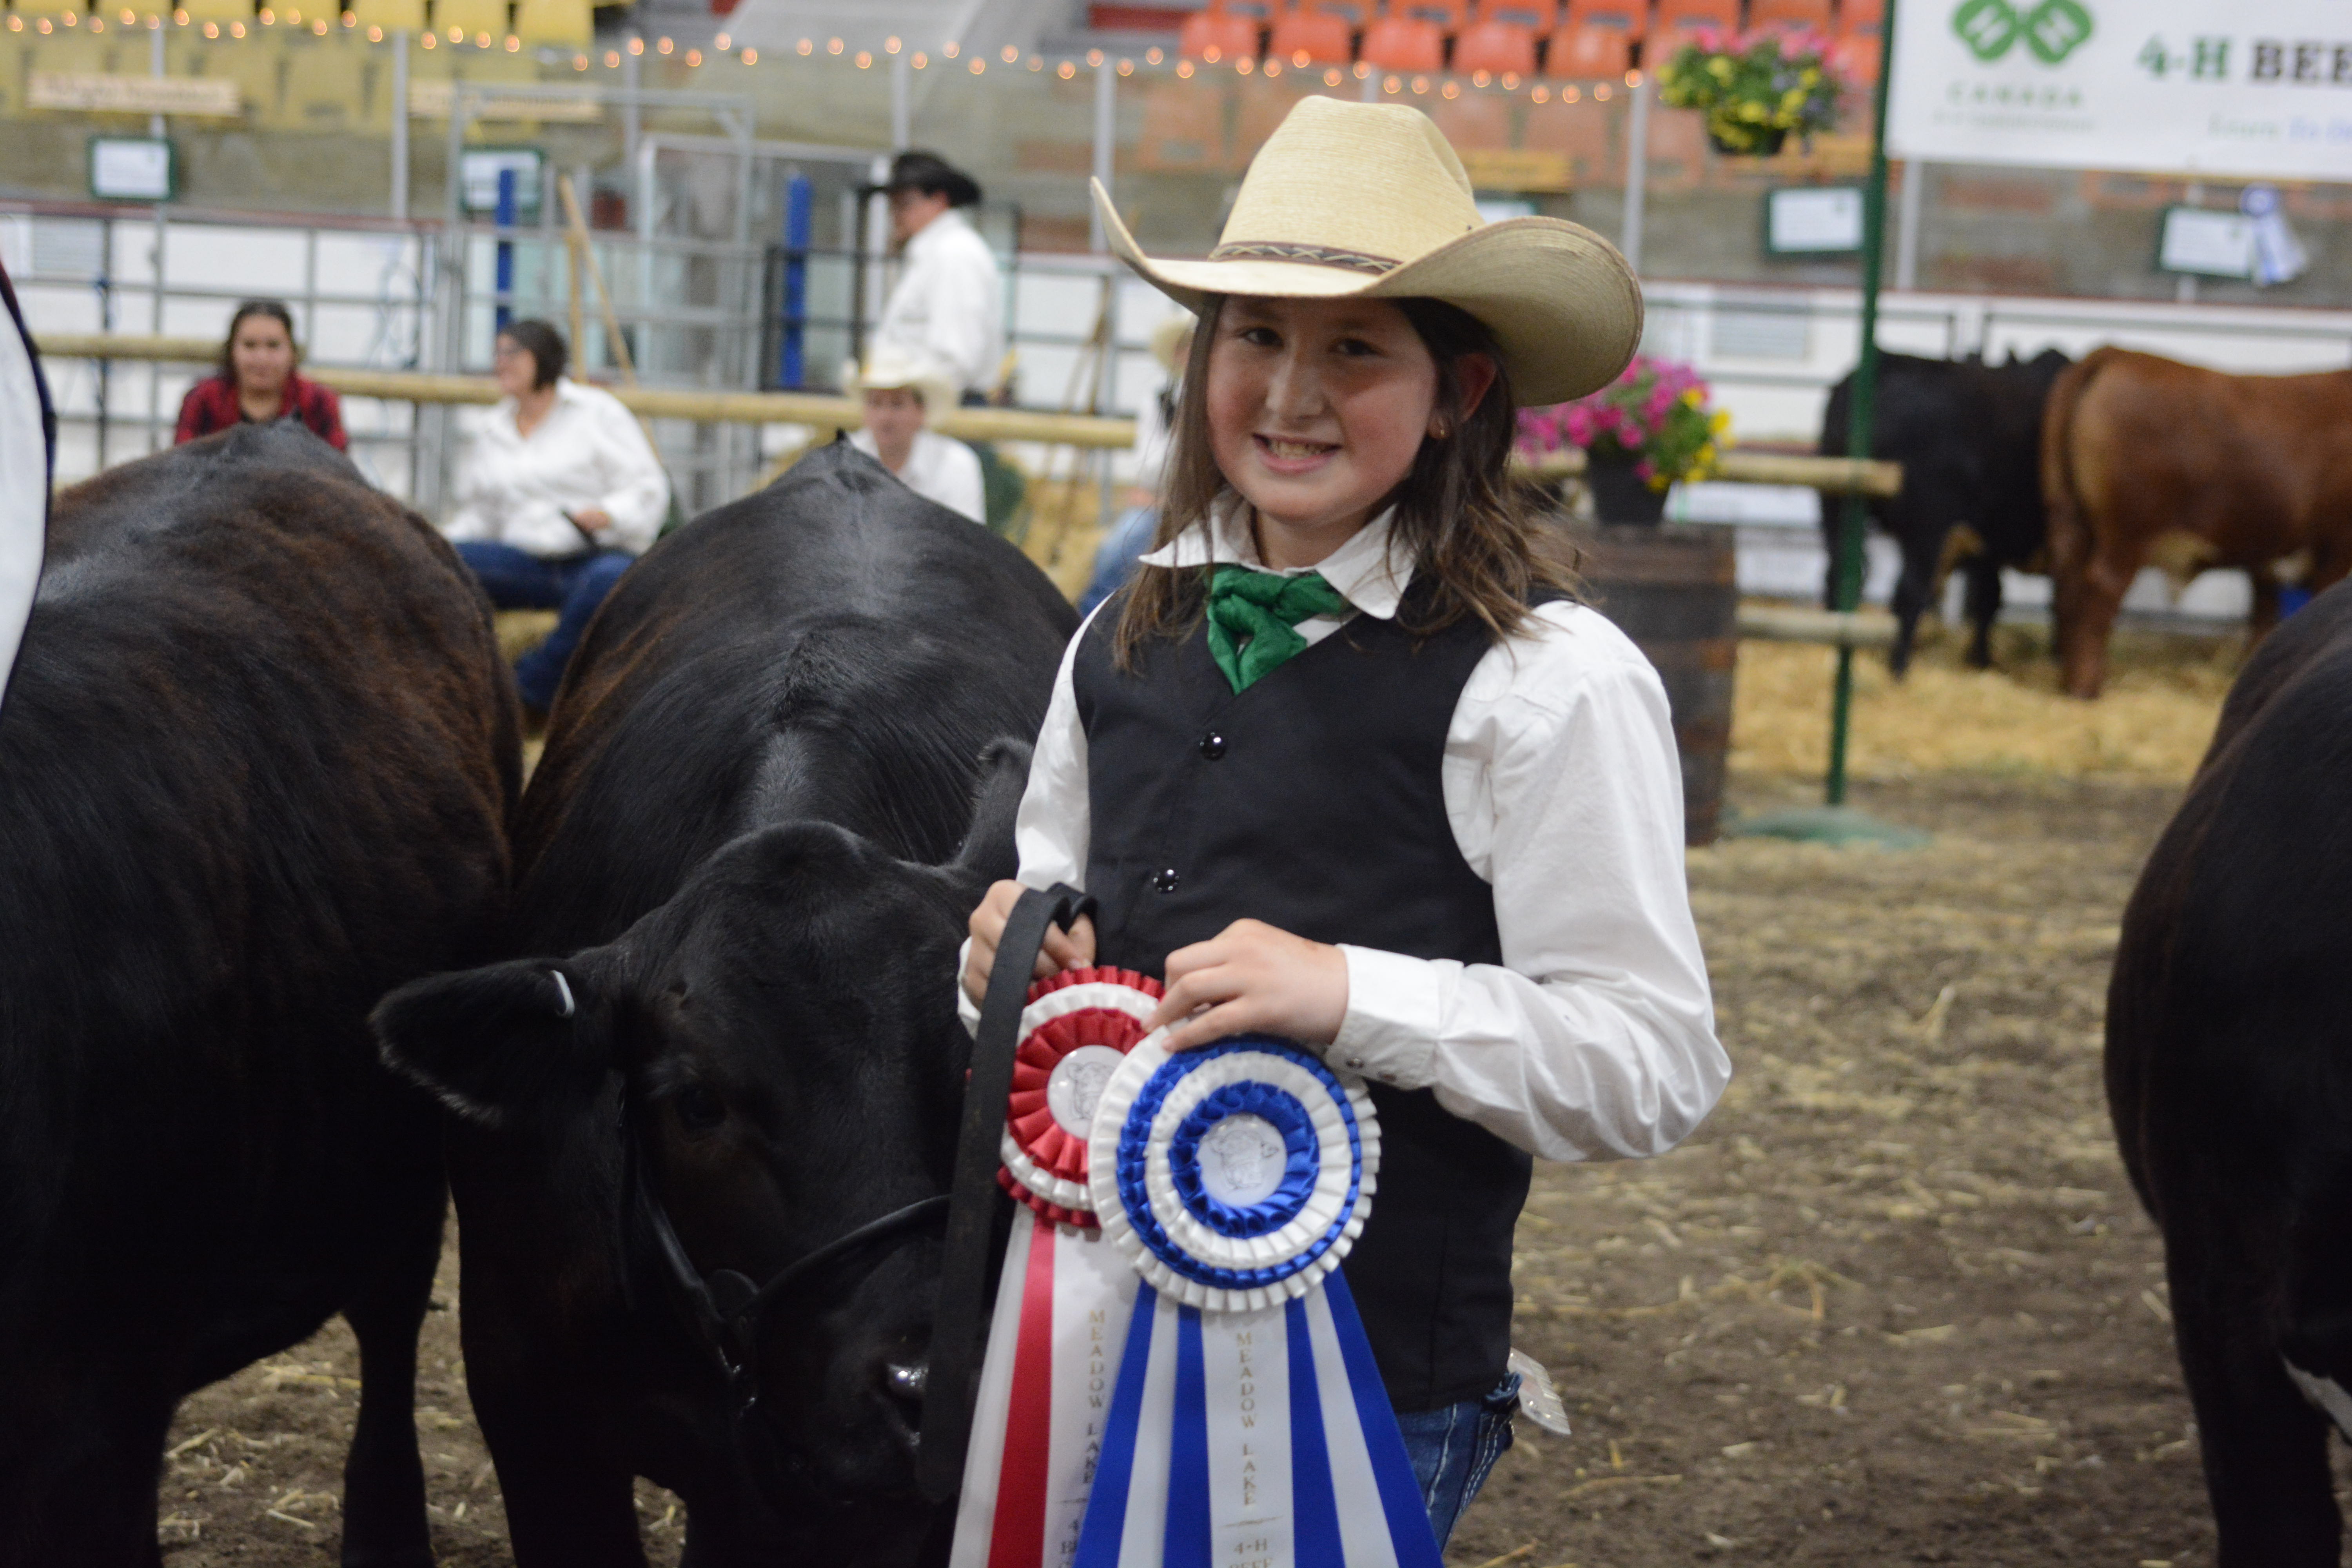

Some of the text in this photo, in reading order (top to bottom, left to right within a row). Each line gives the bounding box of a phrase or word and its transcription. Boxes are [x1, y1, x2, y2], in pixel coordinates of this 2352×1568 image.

[2136, 36, 2230, 80] 4-H
[1089, 1310, 1105, 1408] MEADOW
[1236, 1332, 1256, 1506] MEADOW LAKE
[1234, 1537, 1269, 1555] 4-H
